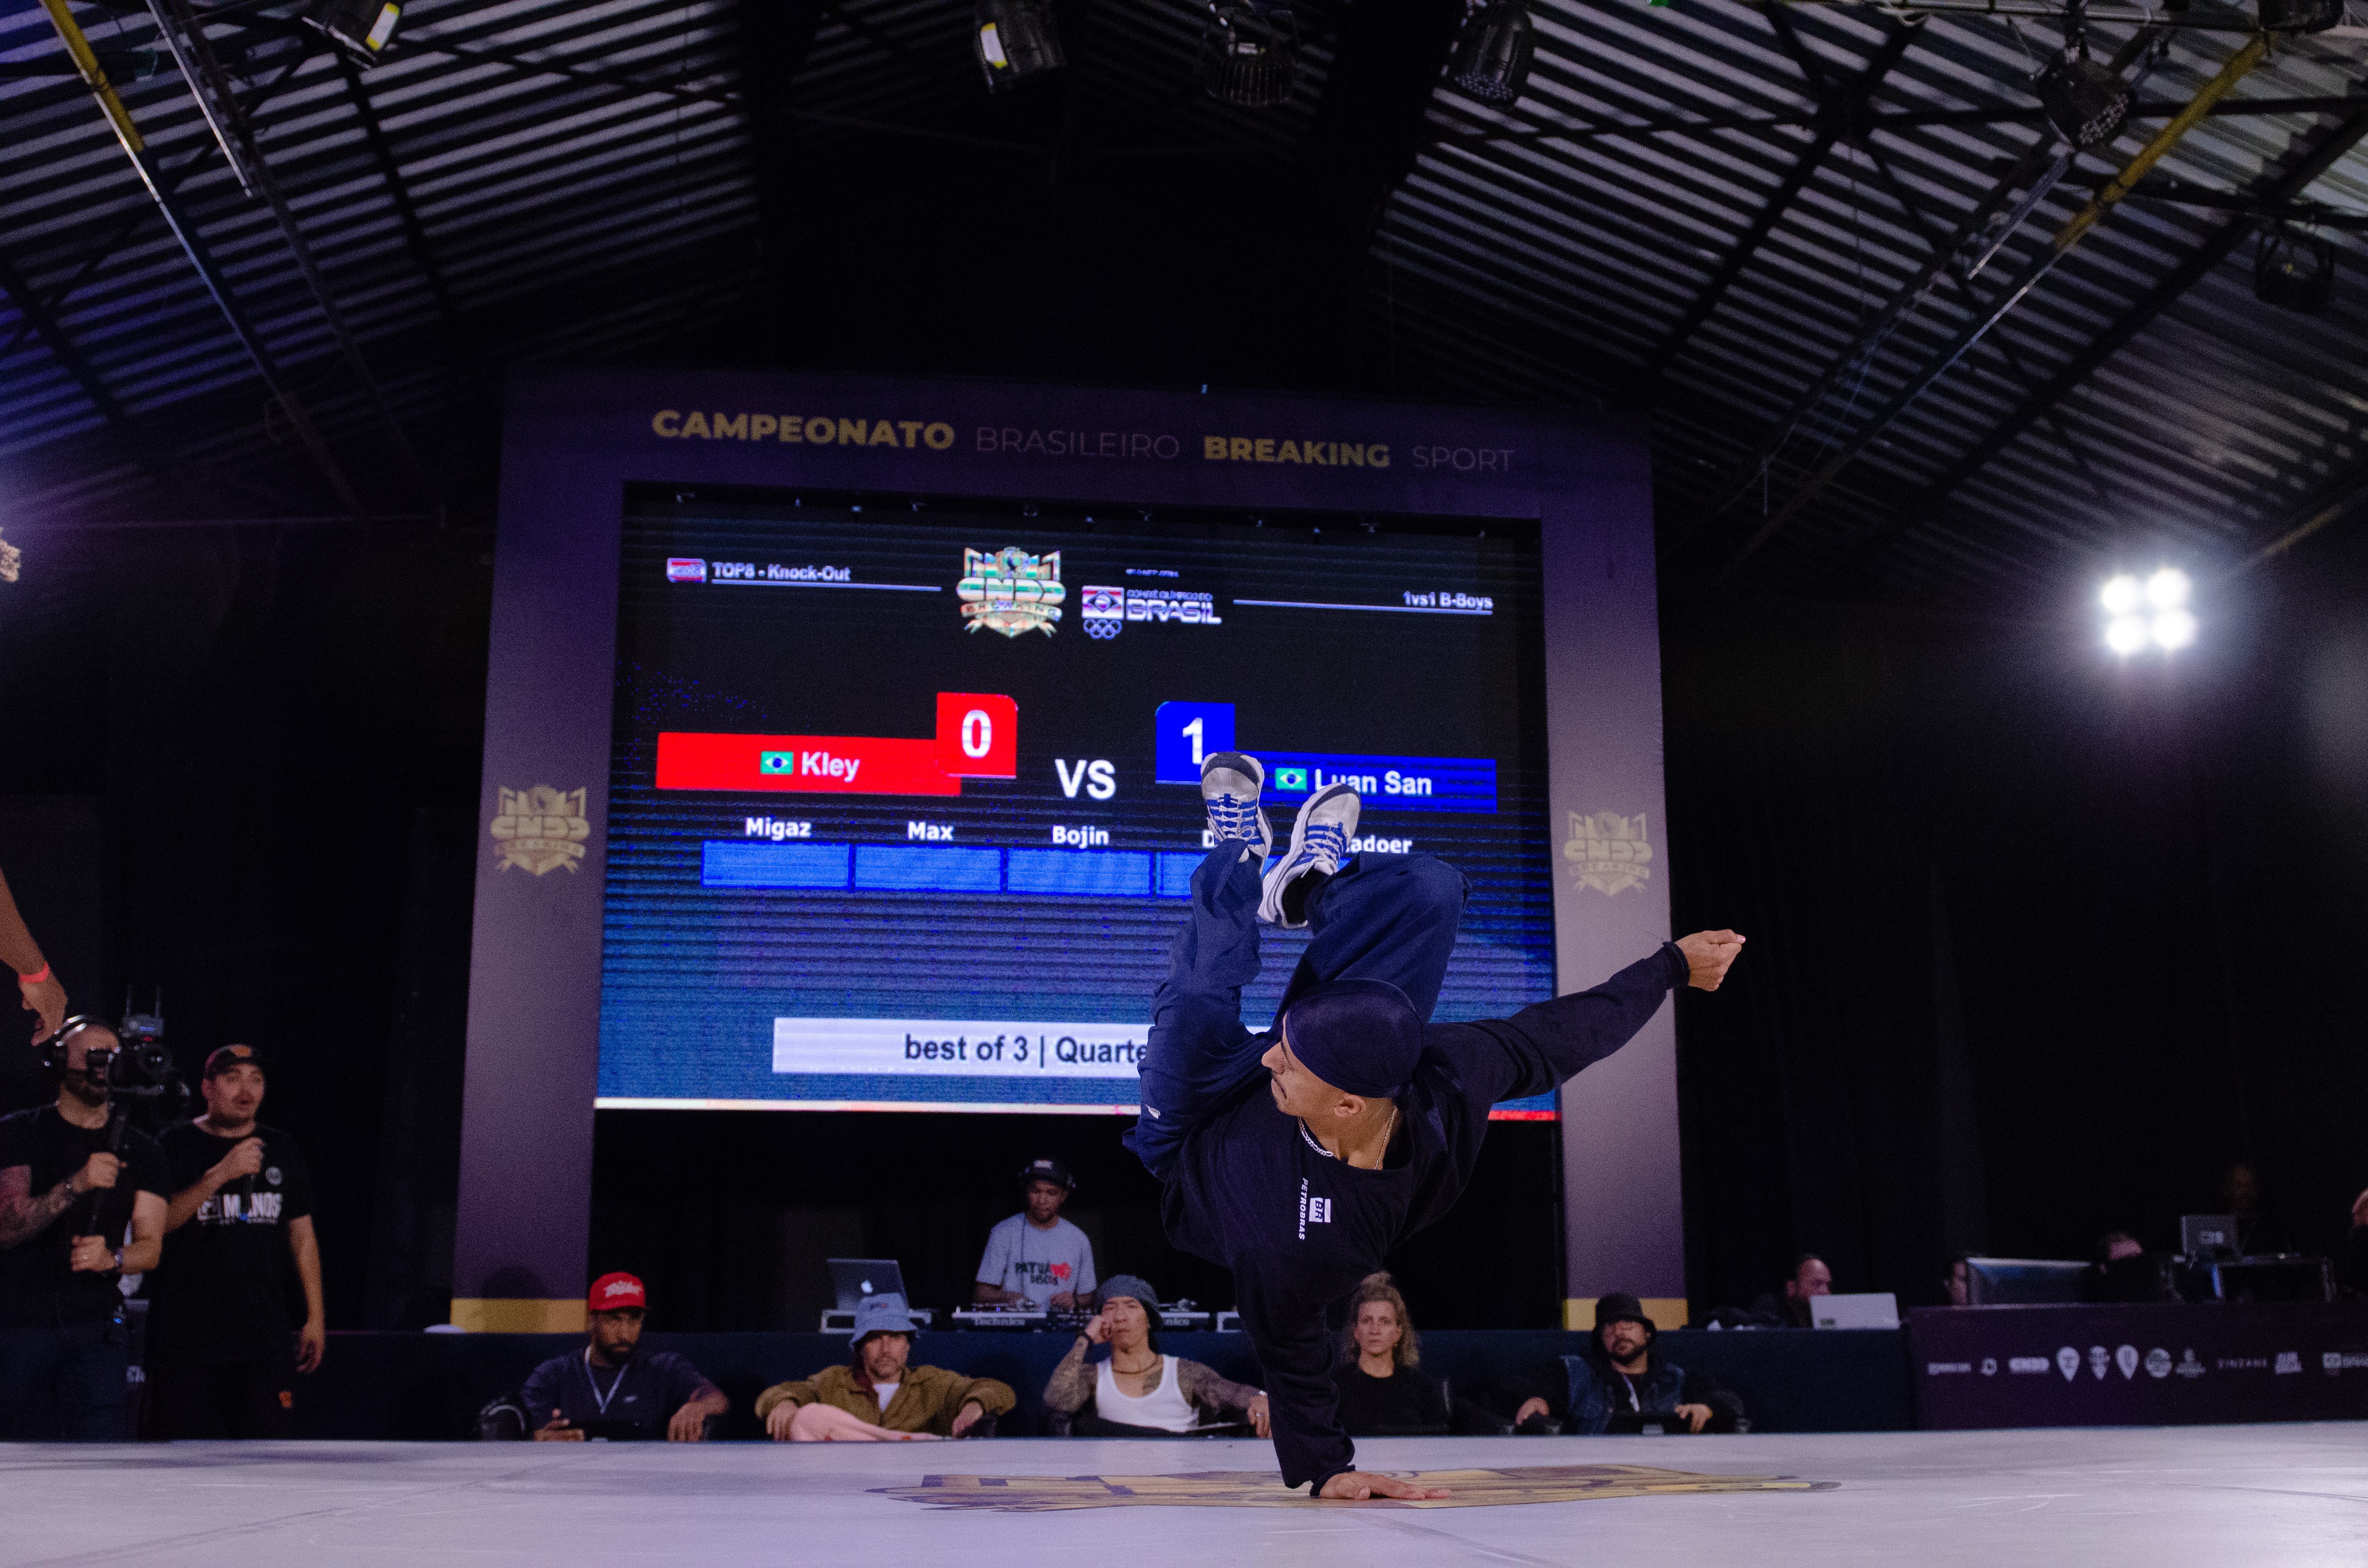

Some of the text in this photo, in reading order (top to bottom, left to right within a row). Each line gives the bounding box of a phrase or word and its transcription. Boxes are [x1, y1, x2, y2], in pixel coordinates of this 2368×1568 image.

[652, 410, 1515, 472] CAMPEONATO BRASILEIRO BREAKING SPORT
[768, 564, 851, 582] Knock-Out
[1126, 599, 1222, 625] BRASIL
[1404, 591, 1493, 610] 1vs1 B-Boys
[962, 709, 992, 758] 0
[1182, 717, 1203, 764] 1
[802, 751, 860, 783] Kley
[1055, 759, 1116, 799] VS
[1384, 770, 1432, 795] San
[745, 817, 812, 841] Migaz
[907, 821, 954, 841] Max
[1052, 825, 1109, 849] Bojin
[1346, 834, 1413, 854] adoer
[905, 1034, 966, 1060] best
[976, 1035, 1003, 1058] of
[1014, 1036, 1029, 1060] 3
[1056, 1036, 1147, 1064] Quarte
[223, 1192, 284, 1219] MNOS
[1299, 1177, 1308, 1240] PETROBRAS
[1315, 1200, 1323, 1219] BR
